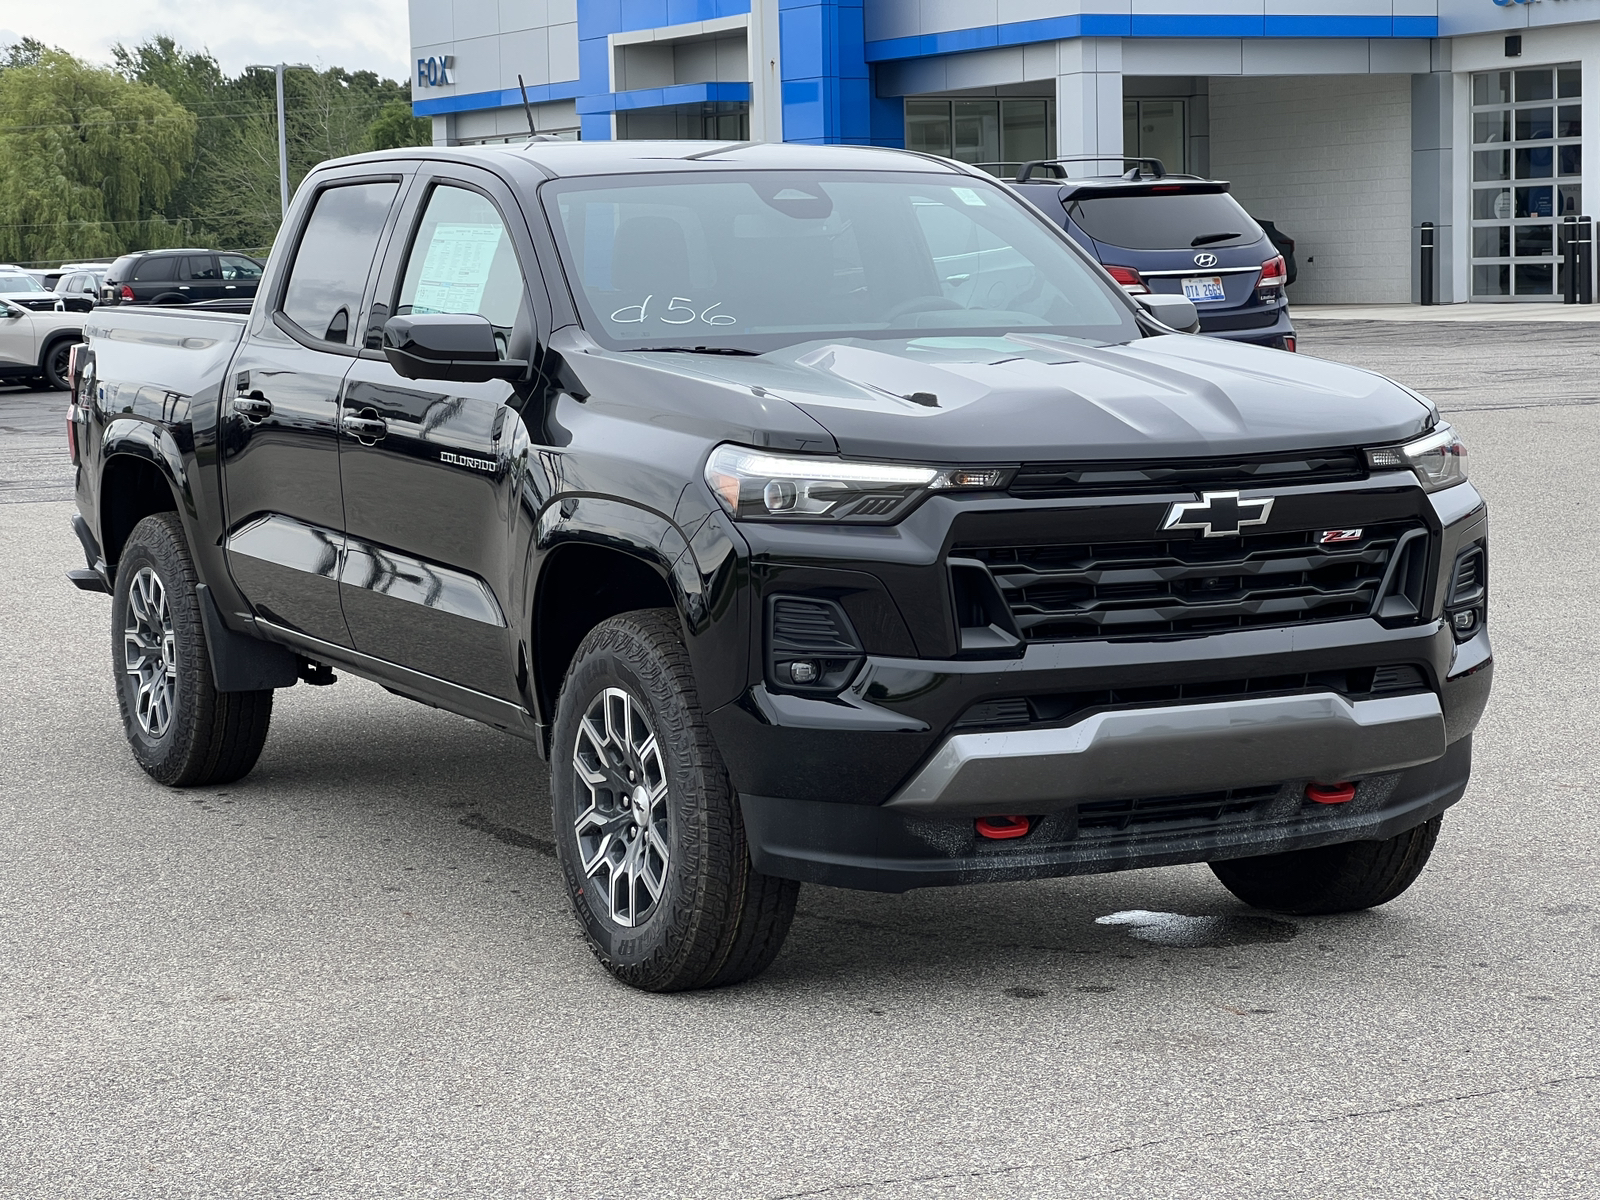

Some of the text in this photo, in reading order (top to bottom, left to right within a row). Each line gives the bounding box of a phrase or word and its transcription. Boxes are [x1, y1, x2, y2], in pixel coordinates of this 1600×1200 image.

[417, 55, 451, 88] FOX
[1185, 284, 1222, 298] DTA 2669
[440, 451, 496, 472] COLORADO
[1320, 529, 1362, 543] Z71
